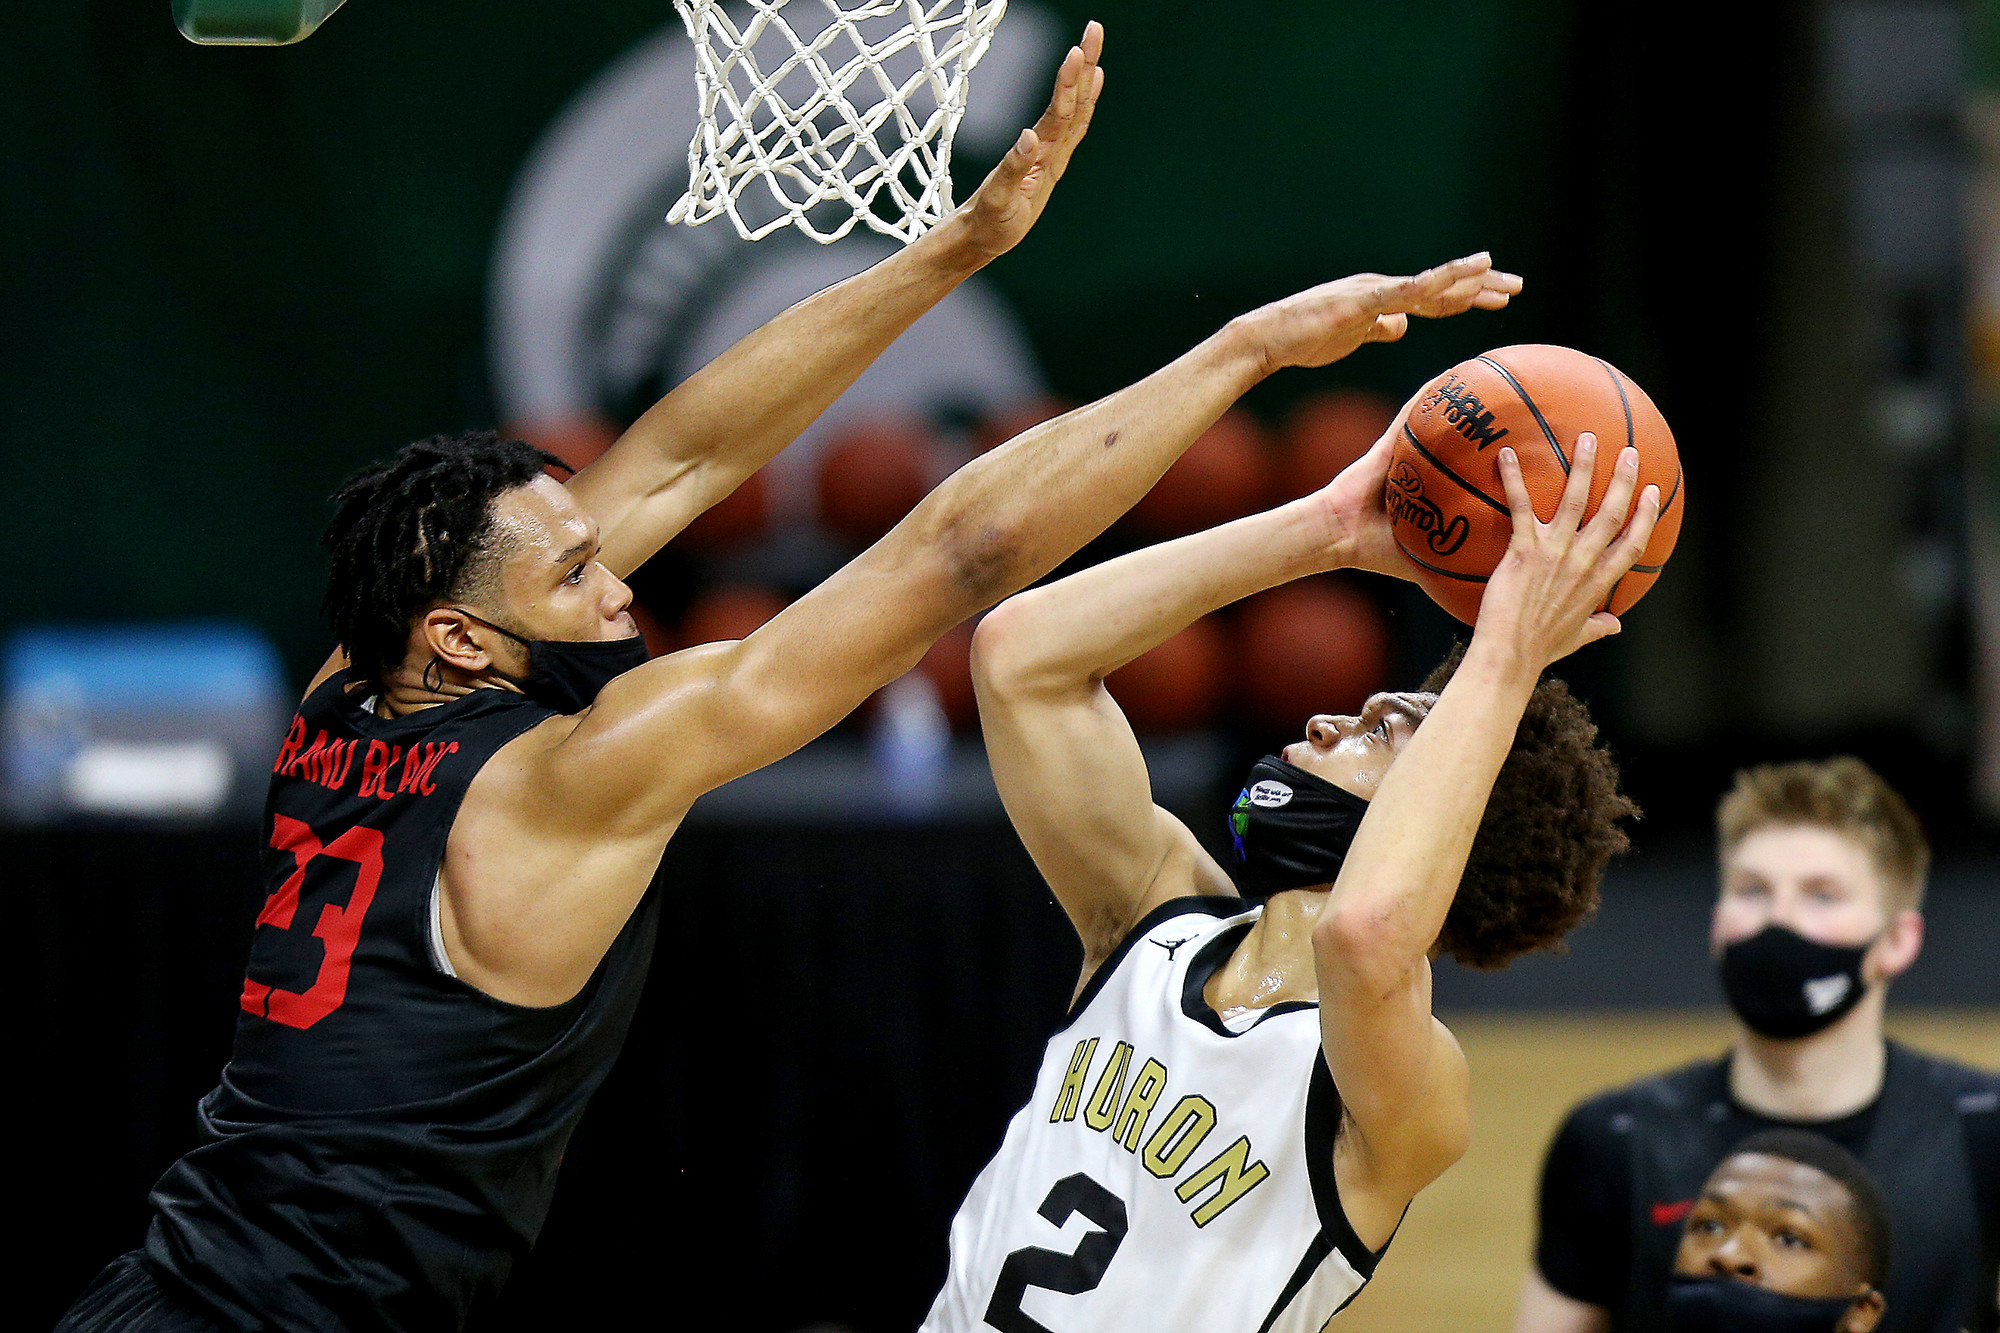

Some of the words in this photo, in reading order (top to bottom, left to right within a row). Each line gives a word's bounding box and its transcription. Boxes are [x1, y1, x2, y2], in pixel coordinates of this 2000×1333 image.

[273, 712, 360, 791] RAND
[240, 812, 386, 1031] 23
[1049, 1036, 1271, 1229] HURON
[982, 1171, 1129, 1333] 2
